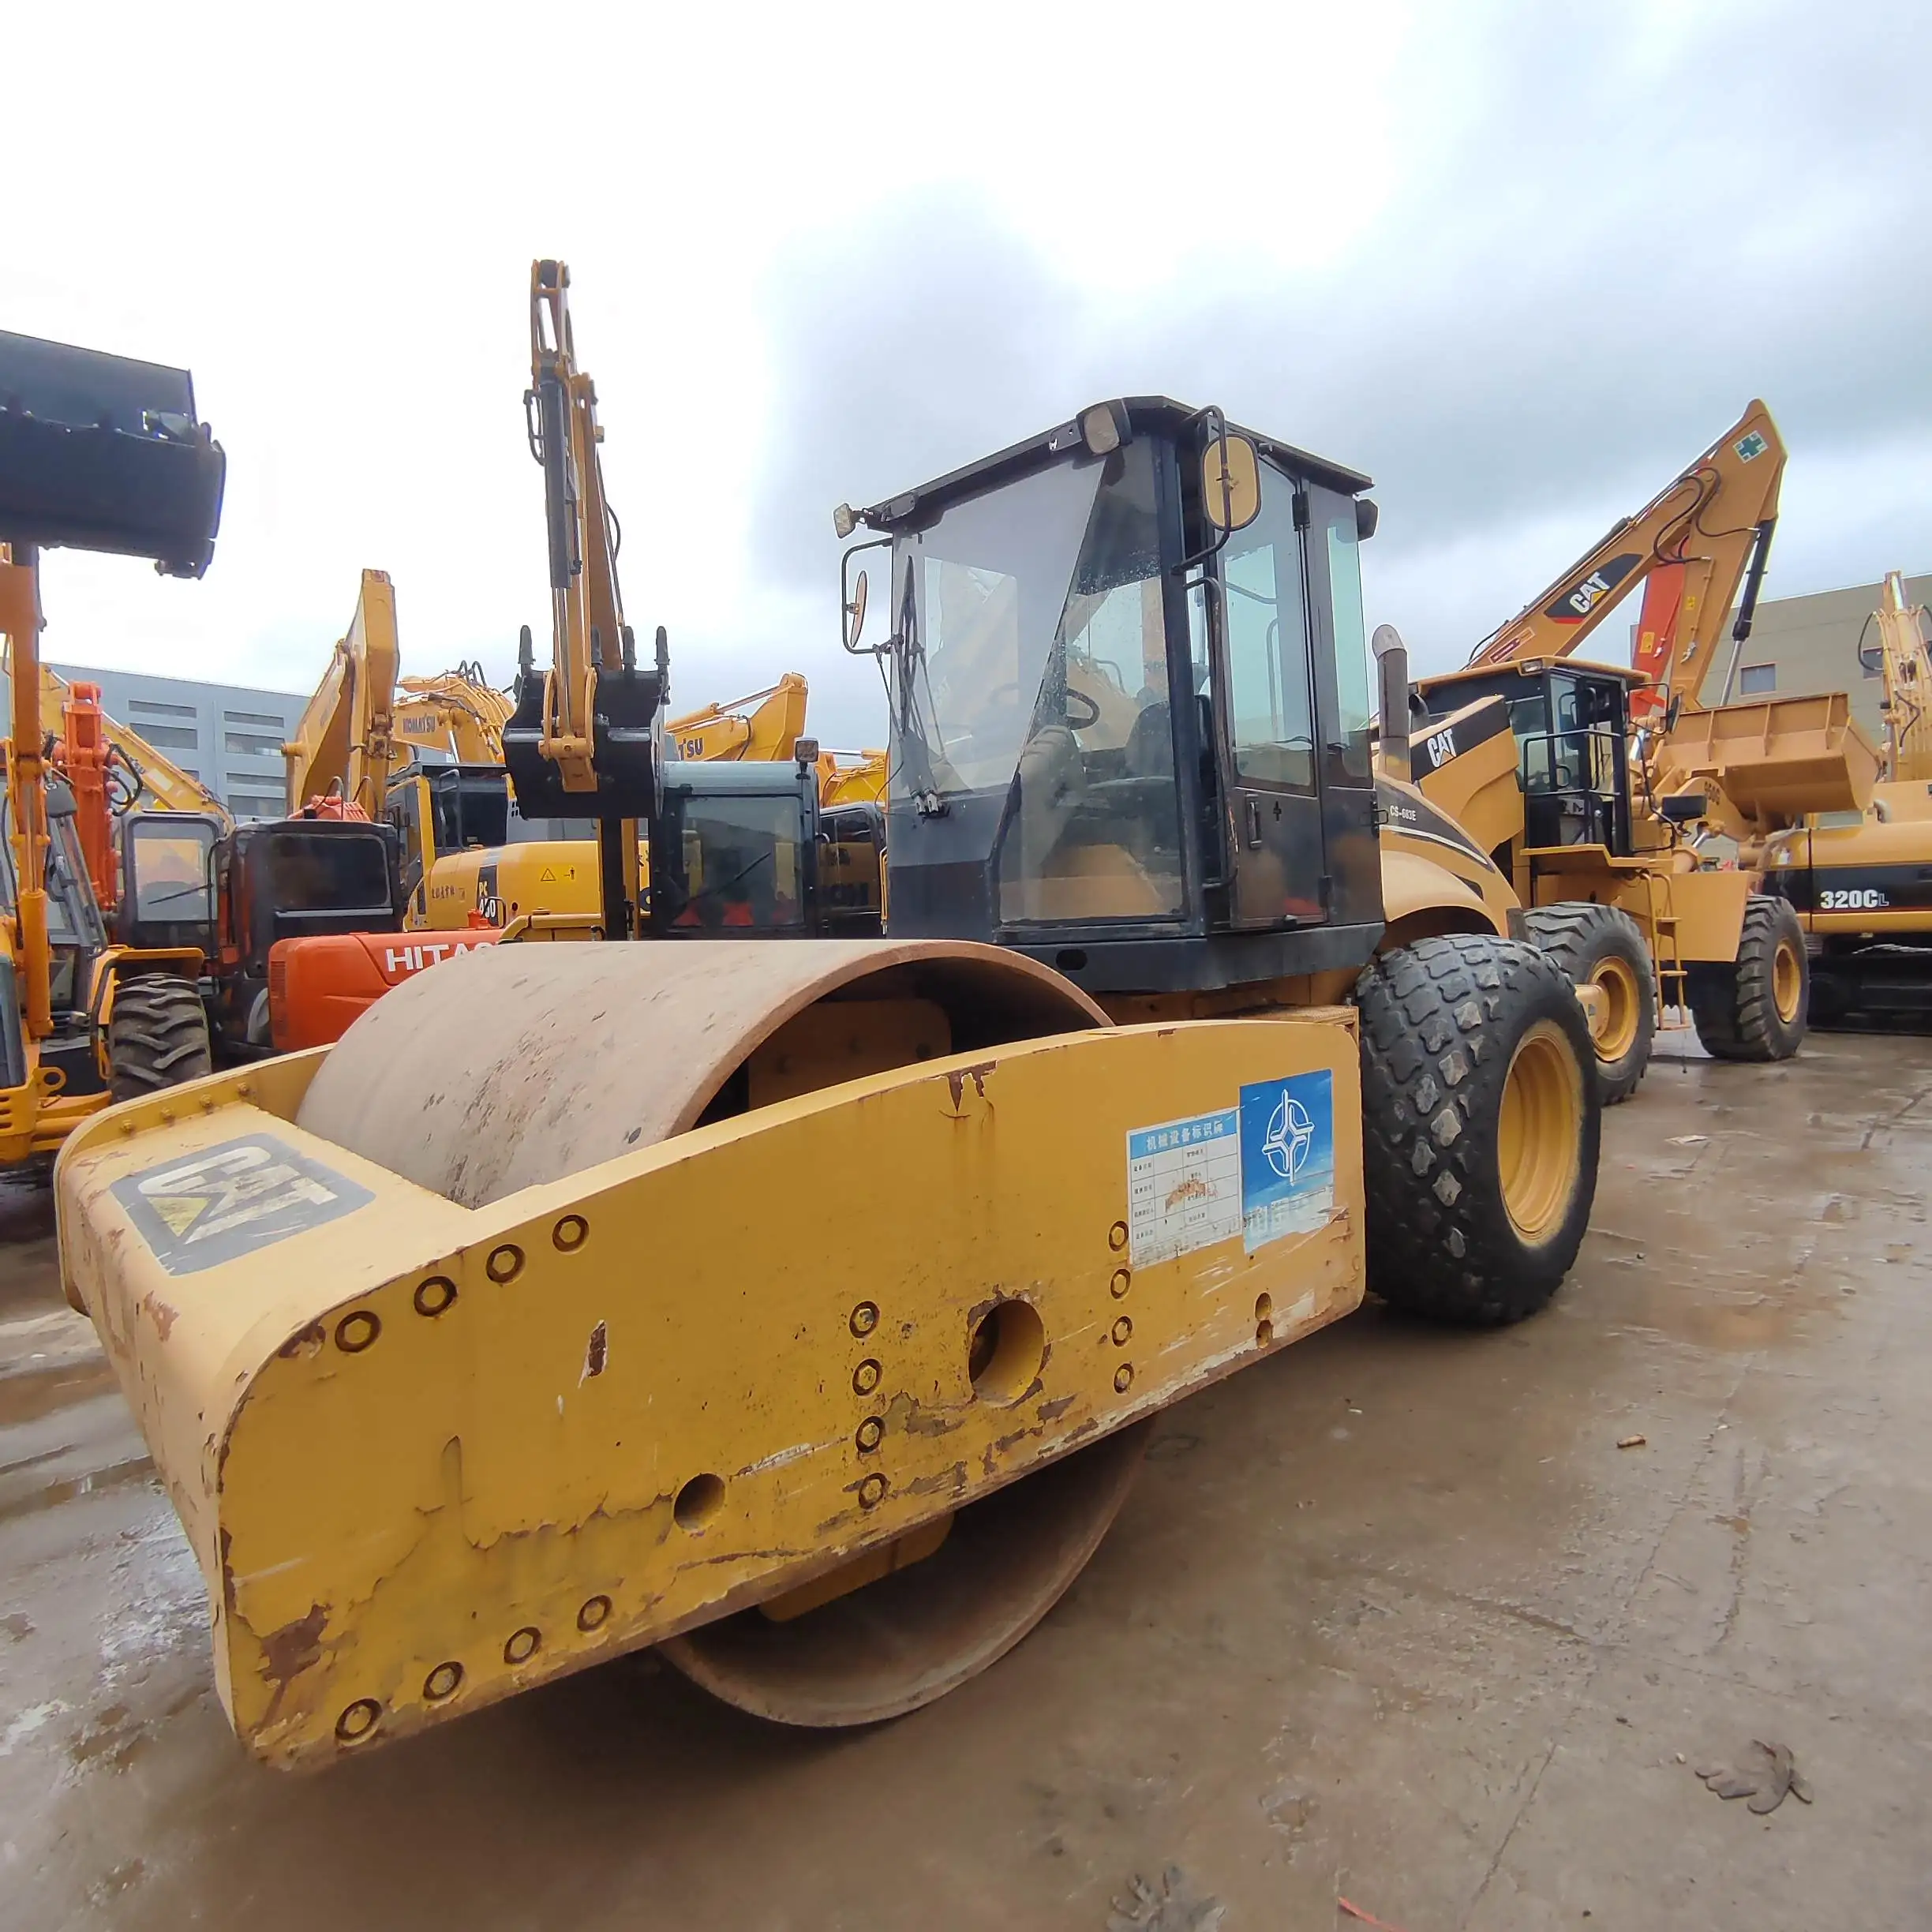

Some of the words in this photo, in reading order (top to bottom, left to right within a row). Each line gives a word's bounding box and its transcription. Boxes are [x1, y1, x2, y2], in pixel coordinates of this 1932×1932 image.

[1569, 571, 1611, 613] CAT
[402, 713, 436, 734] KOMATSU
[1427, 728, 1457, 768] CAT
[478, 881, 488, 897] PC
[385, 942, 493, 972] HITA
[137, 1146, 339, 1245] CAT
